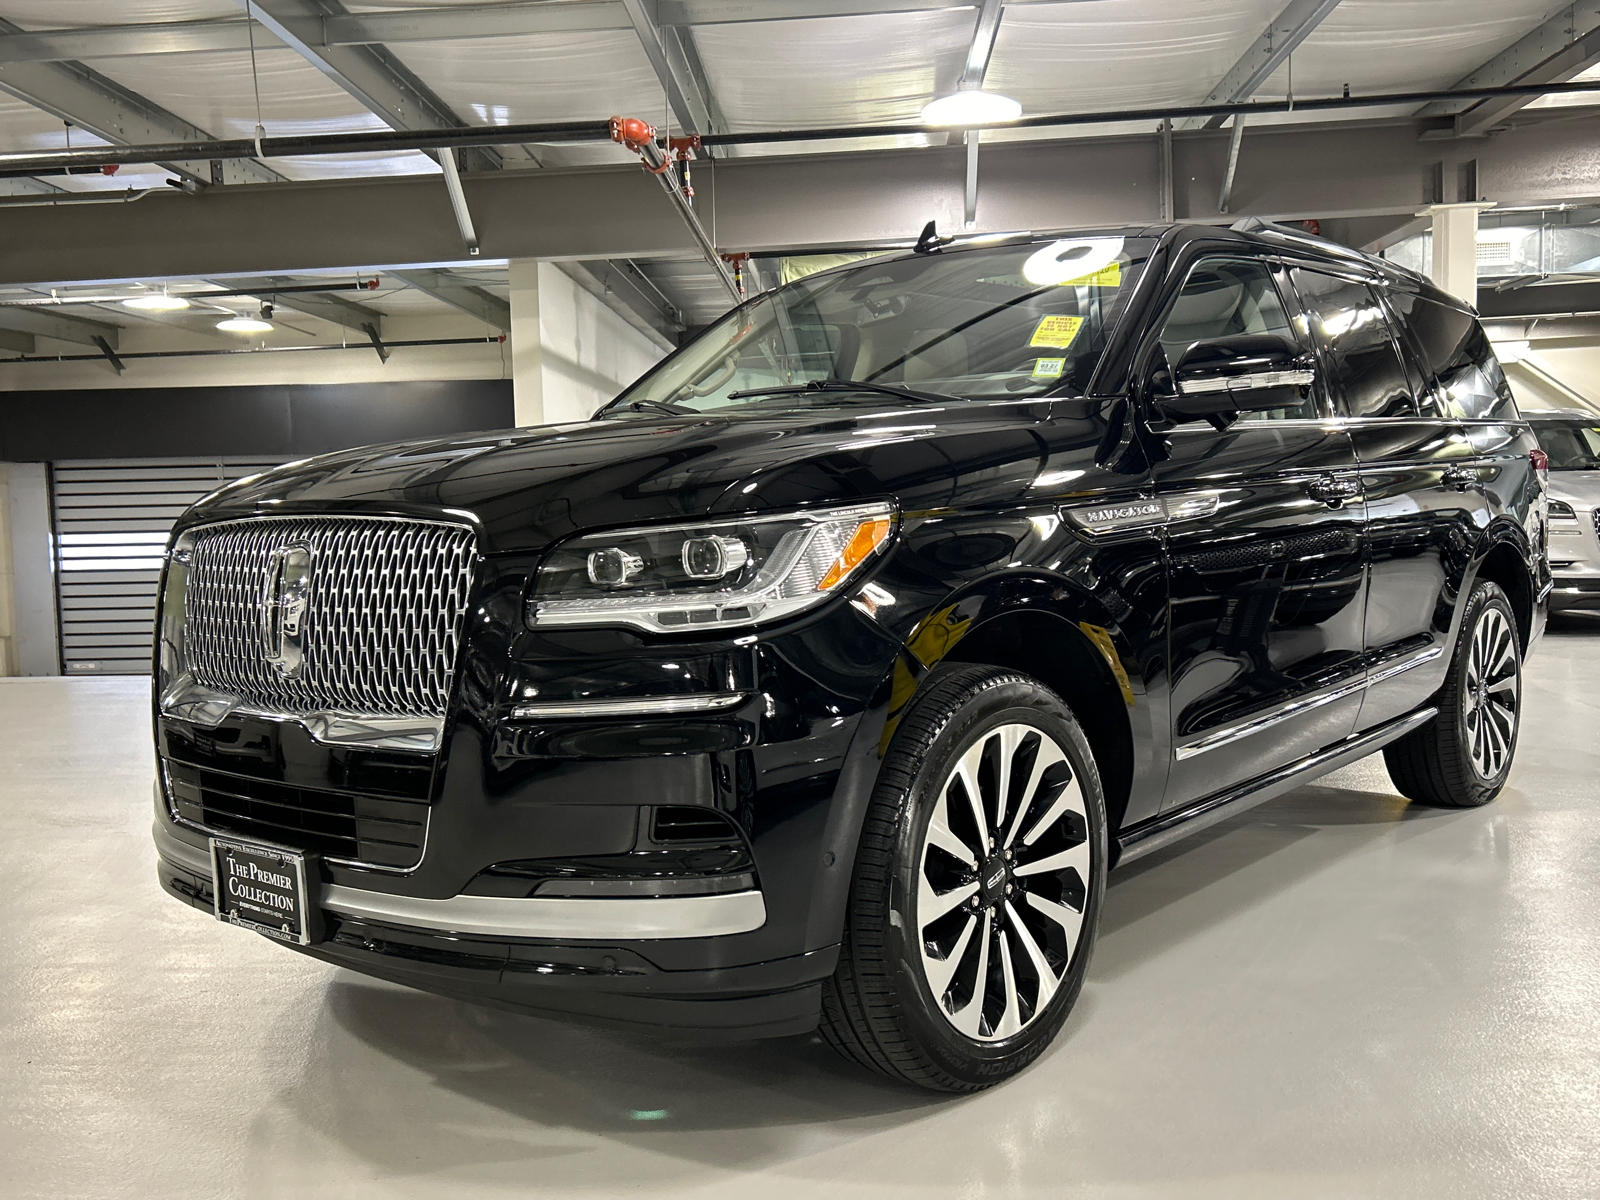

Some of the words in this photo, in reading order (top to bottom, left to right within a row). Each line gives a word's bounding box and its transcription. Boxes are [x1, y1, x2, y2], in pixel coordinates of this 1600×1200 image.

[1086, 504, 1160, 523] NAVIGATOR
[242, 846, 268, 857] EXCELLENCE
[268, 851, 281, 860] SINCE
[226, 857, 249, 879] THE
[249, 862, 293, 891] PREMIER
[228, 876, 294, 912] COLLECTION
[239, 901, 261, 912] EVERYTHING
[976, 1024, 1056, 1076] SCORPION
